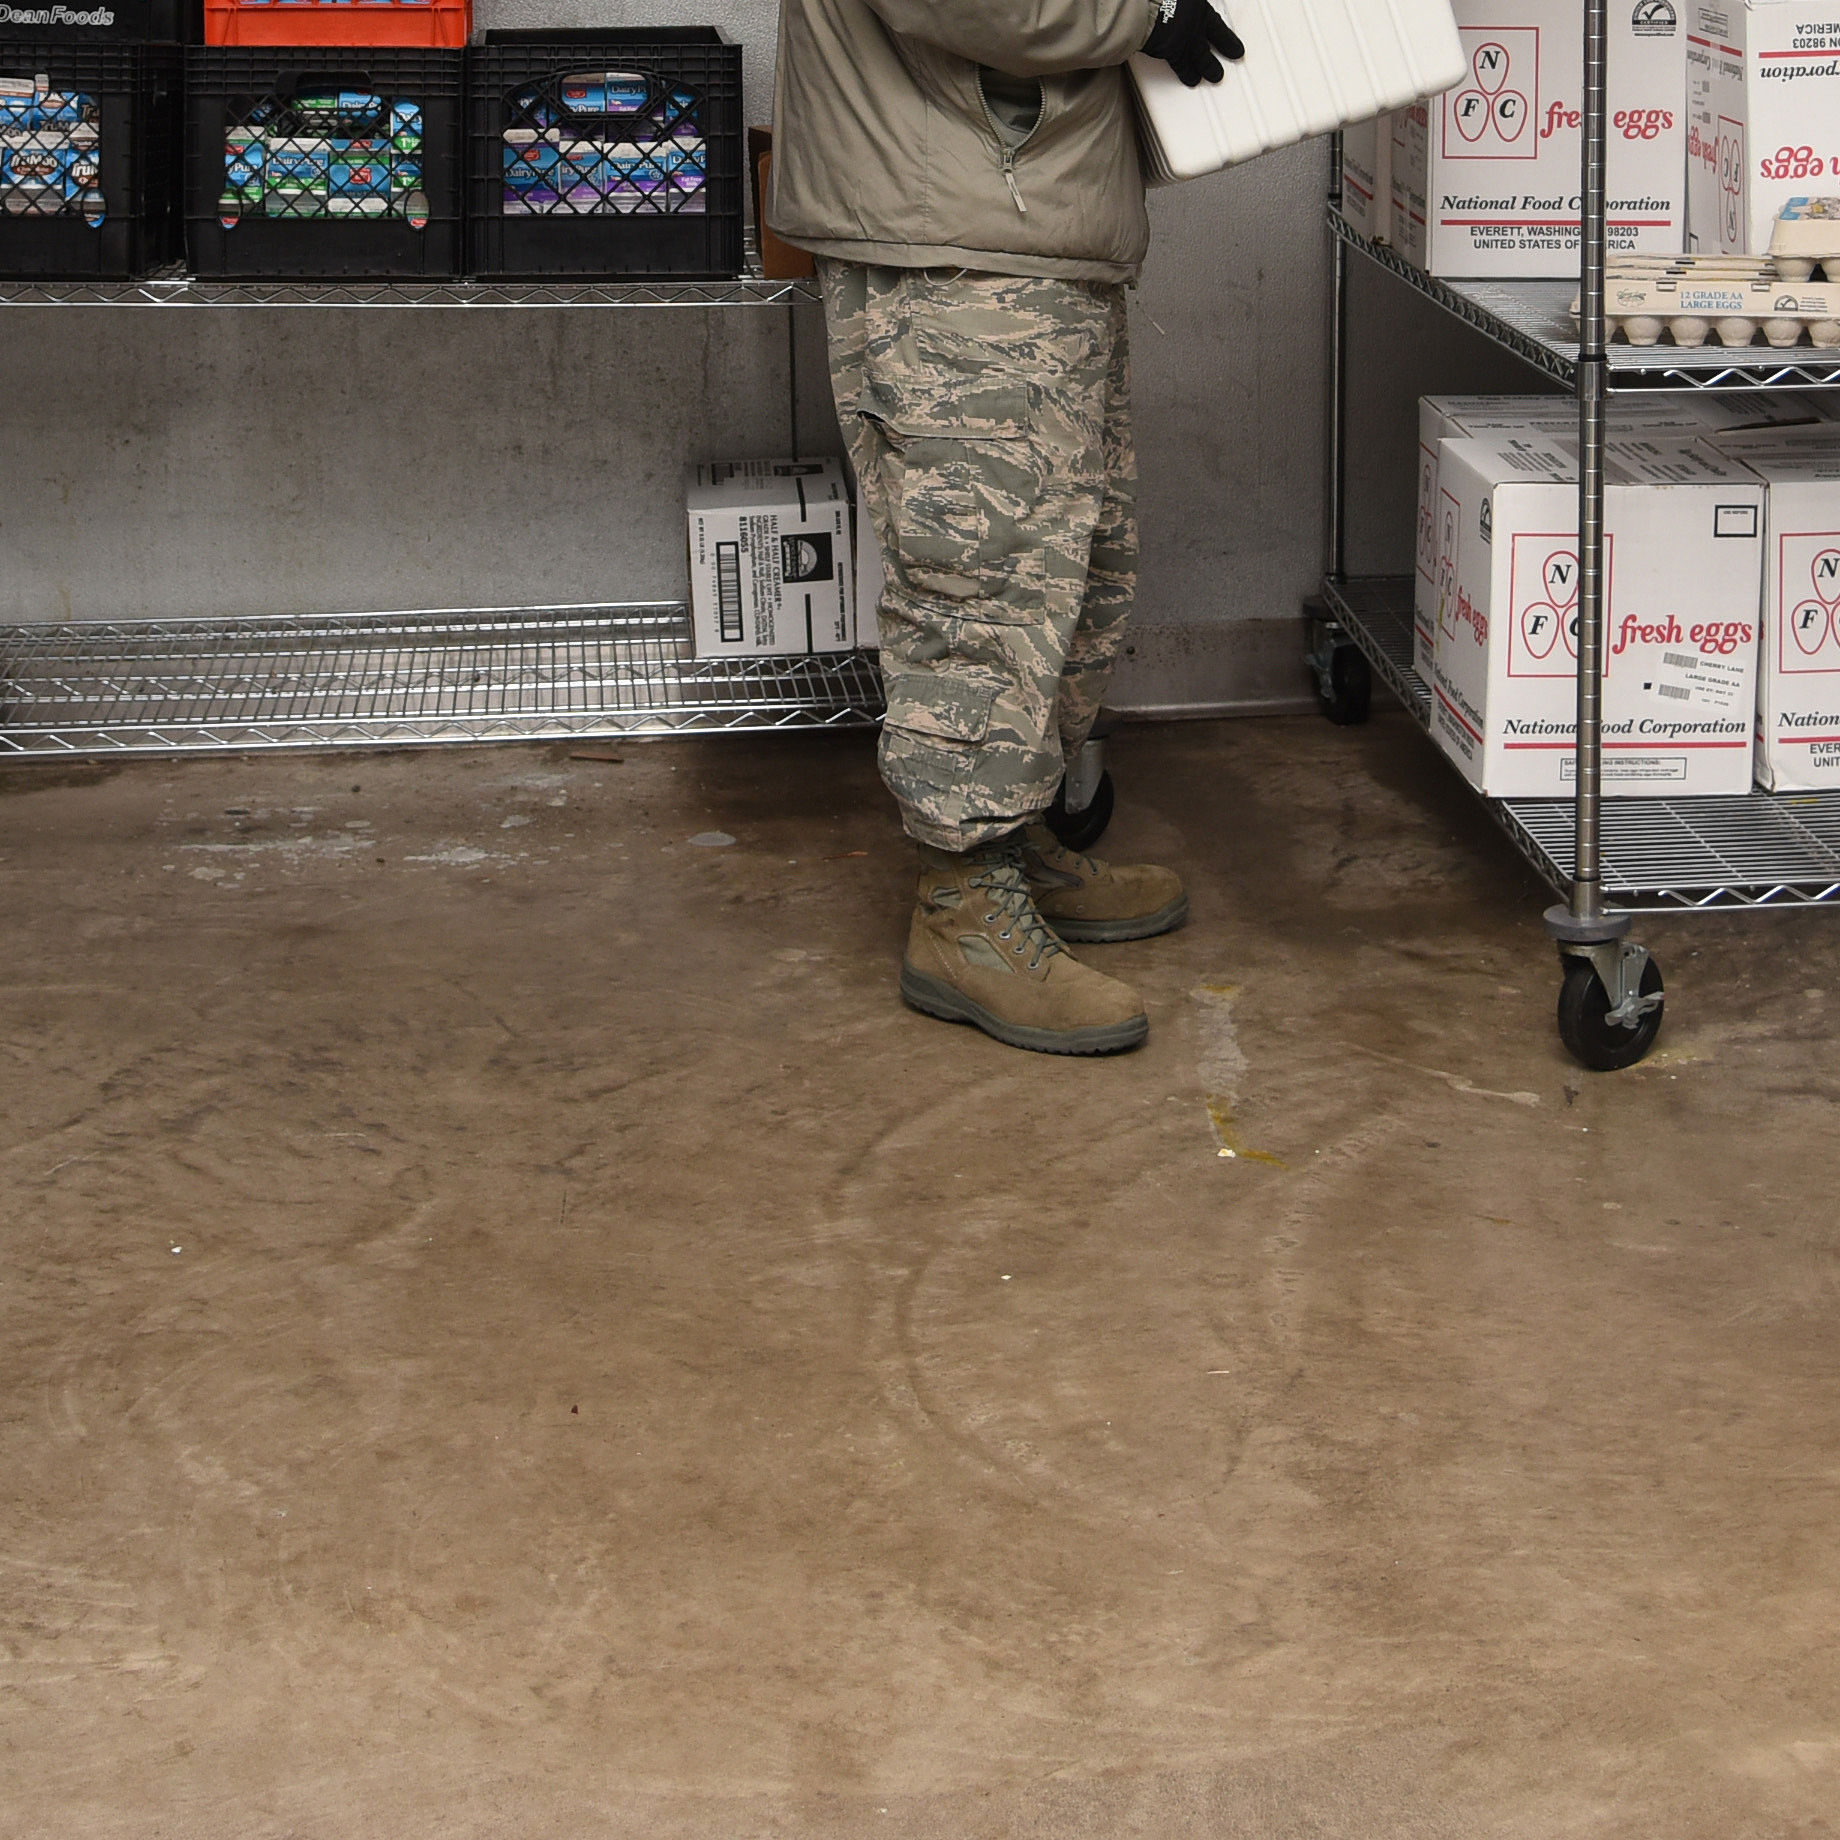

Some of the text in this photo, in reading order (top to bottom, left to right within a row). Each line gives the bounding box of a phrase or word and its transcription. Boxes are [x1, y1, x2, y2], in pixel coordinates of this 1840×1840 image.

[1792, 37, 1826, 49] 98203
[1479, 50, 1501, 69] N
[1461, 98, 1516, 118] F C
[1613, 109, 1673, 140] eggs
[1760, 146, 1823, 180] eggs
[1440, 195, 1562, 211] National Food
[1470, 226, 1639, 238] EVERETT, WASHING 98203
[1473, 239, 1580, 250] UNITED STATES OF
[1680, 291, 1744, 300] 12 GRADE AA
[1680, 300, 1743, 310] LARGE EGGS
[1548, 563, 1572, 585] N
[1818, 558, 1840, 578] N
[1528, 615, 1548, 635] F
[1799, 609, 1818, 629] F
[1612, 614, 1753, 655] fresh eggs
[1699, 660, 1744, 674] CHERRY LANE
[1685, 673, 1706, 682] LARGE
[1707, 676, 1730, 686] GRADE
[1638, 718, 1746, 738] Corporation
